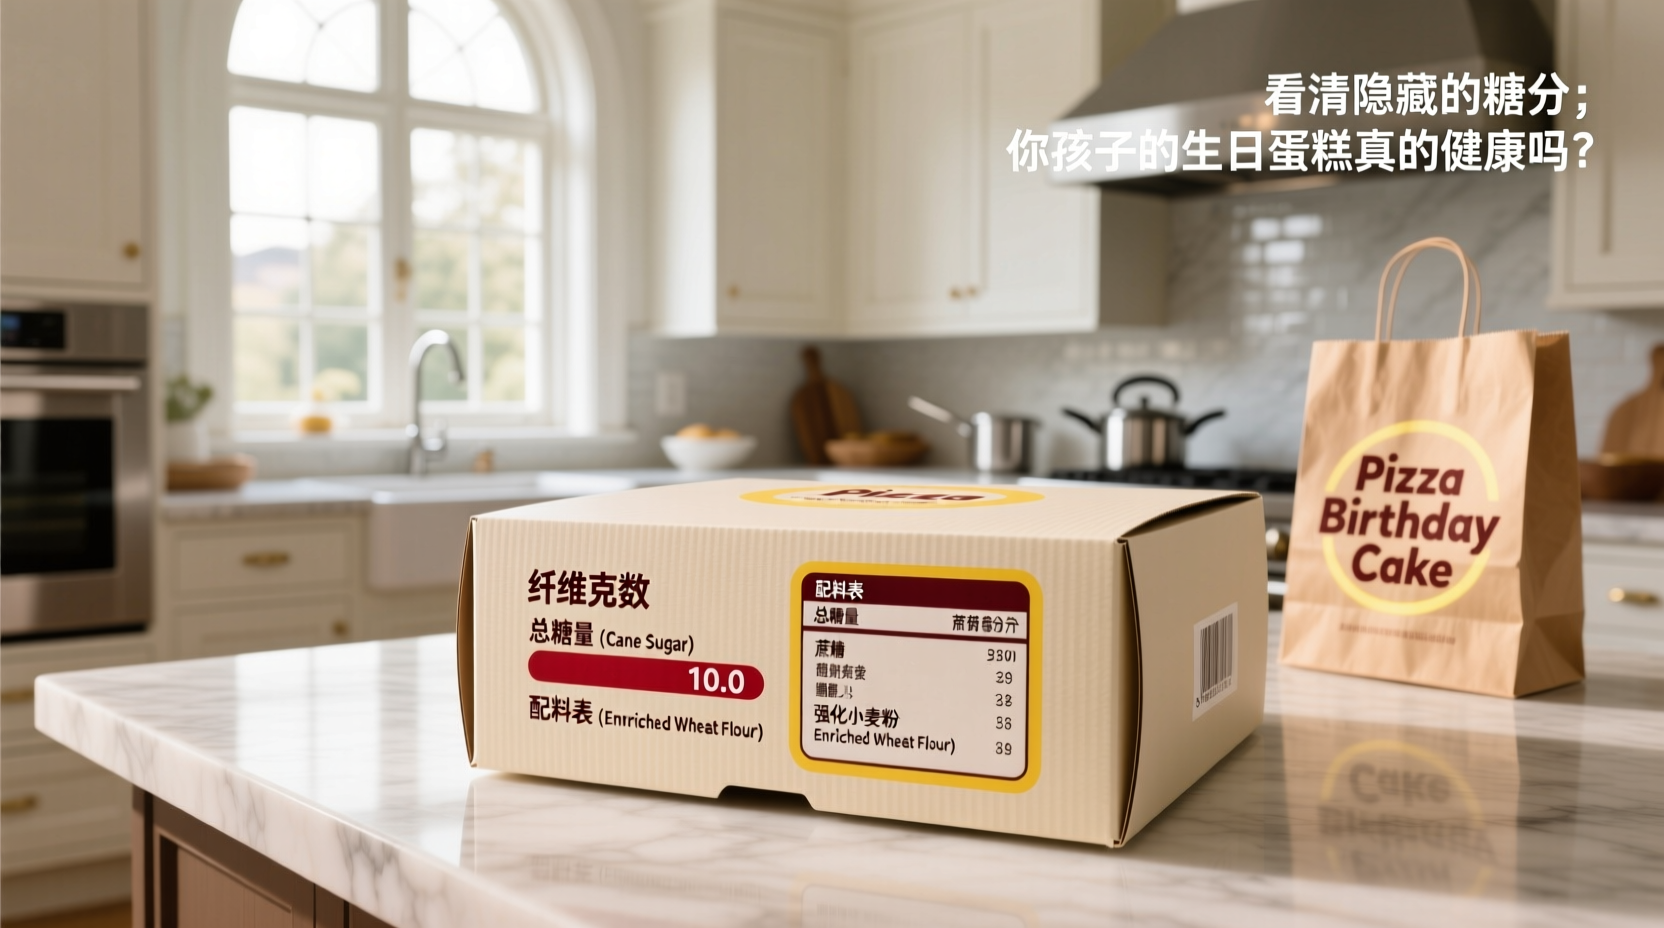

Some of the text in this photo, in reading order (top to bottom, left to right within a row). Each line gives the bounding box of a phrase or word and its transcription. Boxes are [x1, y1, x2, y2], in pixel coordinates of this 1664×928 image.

[1355, 453, 1465, 496] Pizza
[1319, 496, 1501, 556] Birthday
[1351, 543, 1453, 588] Cake
[527, 568, 651, 610] 纤维克数
[815, 579, 864, 600] 配料表
[529, 617, 594, 647] 总糖量
[599, 629, 695, 656] (Cane Sugar)
[688, 666, 746, 695] 10.0
[529, 694, 593, 726] 配料表
[813, 703, 901, 729] 强化小麦粉
[674, 716, 719, 736] Wheat
[721, 721, 764, 743] Flour)
[813, 728, 956, 756] Enriched Wheat Flour)
